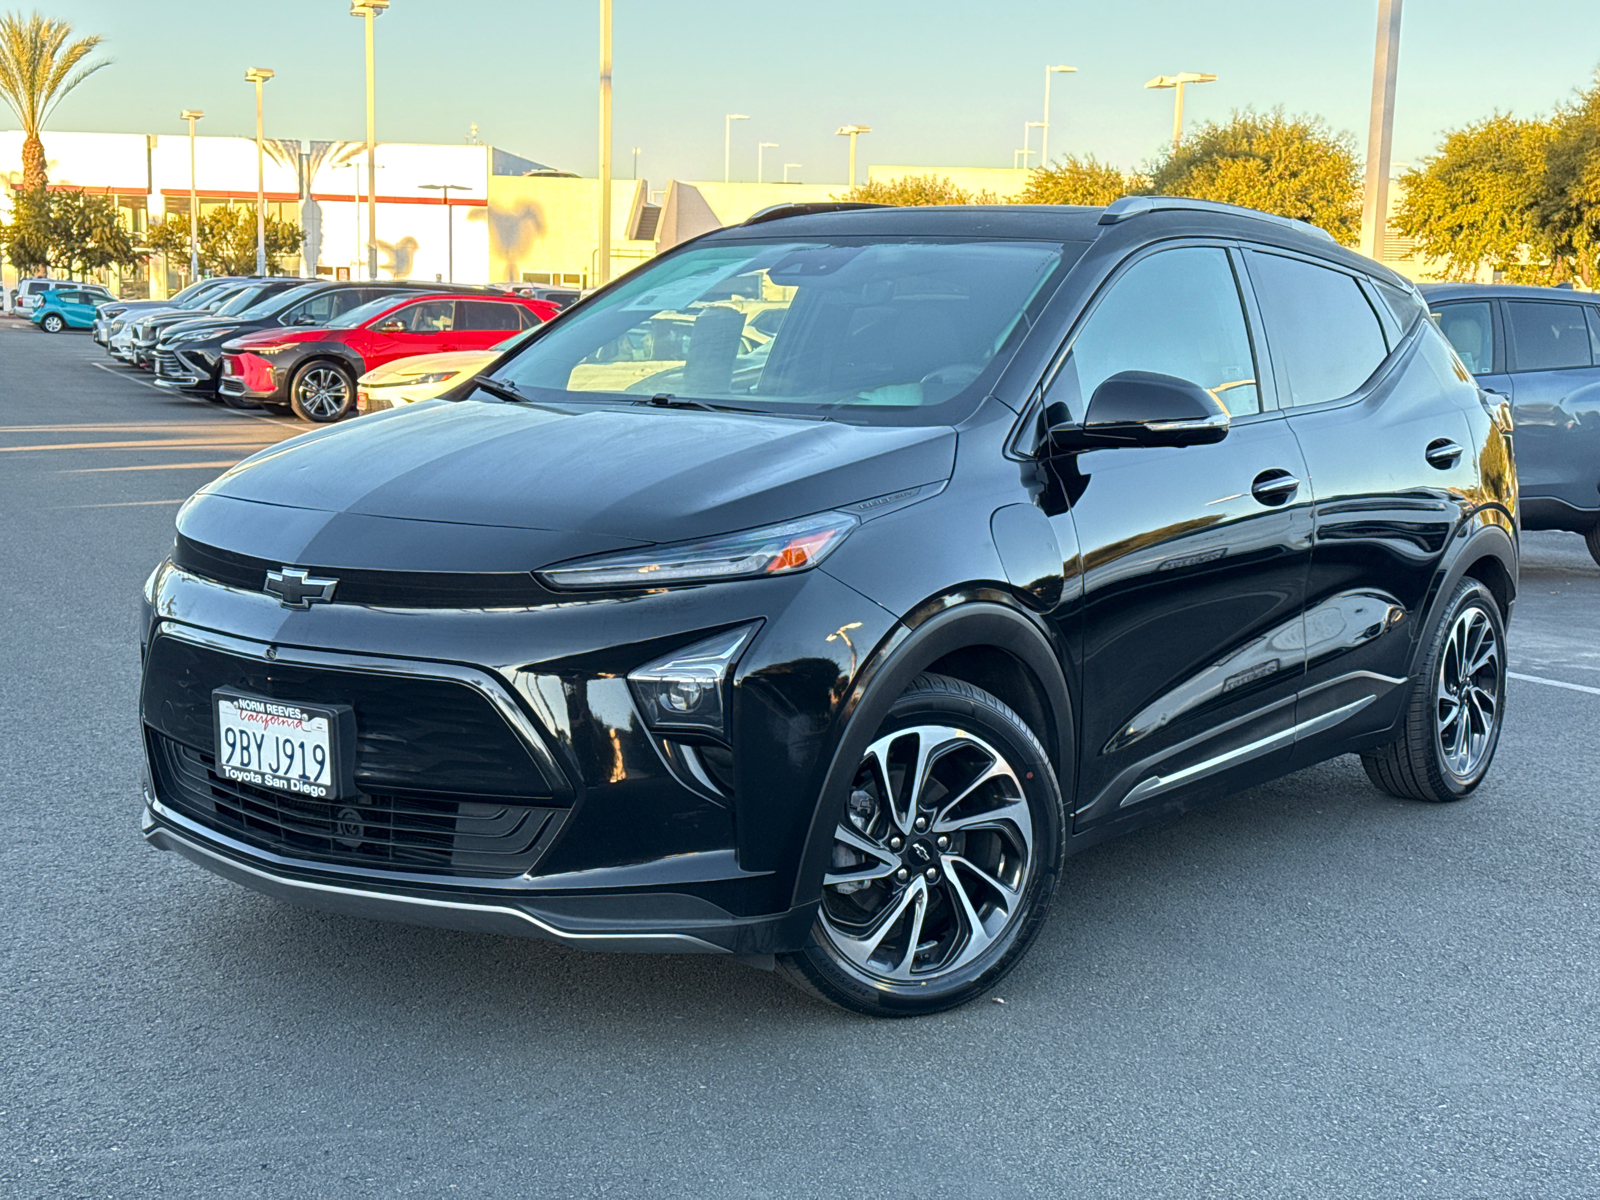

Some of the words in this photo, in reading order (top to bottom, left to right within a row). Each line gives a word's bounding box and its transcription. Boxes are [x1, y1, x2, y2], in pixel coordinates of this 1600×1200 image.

[239, 699, 264, 712] NORM
[266, 704, 301, 719] REEVES
[239, 710, 312, 732] California
[224, 727, 326, 782] 9BYJ919
[223, 766, 262, 784] Toyota
[265, 774, 287, 789] San
[290, 780, 326, 797] Diego
